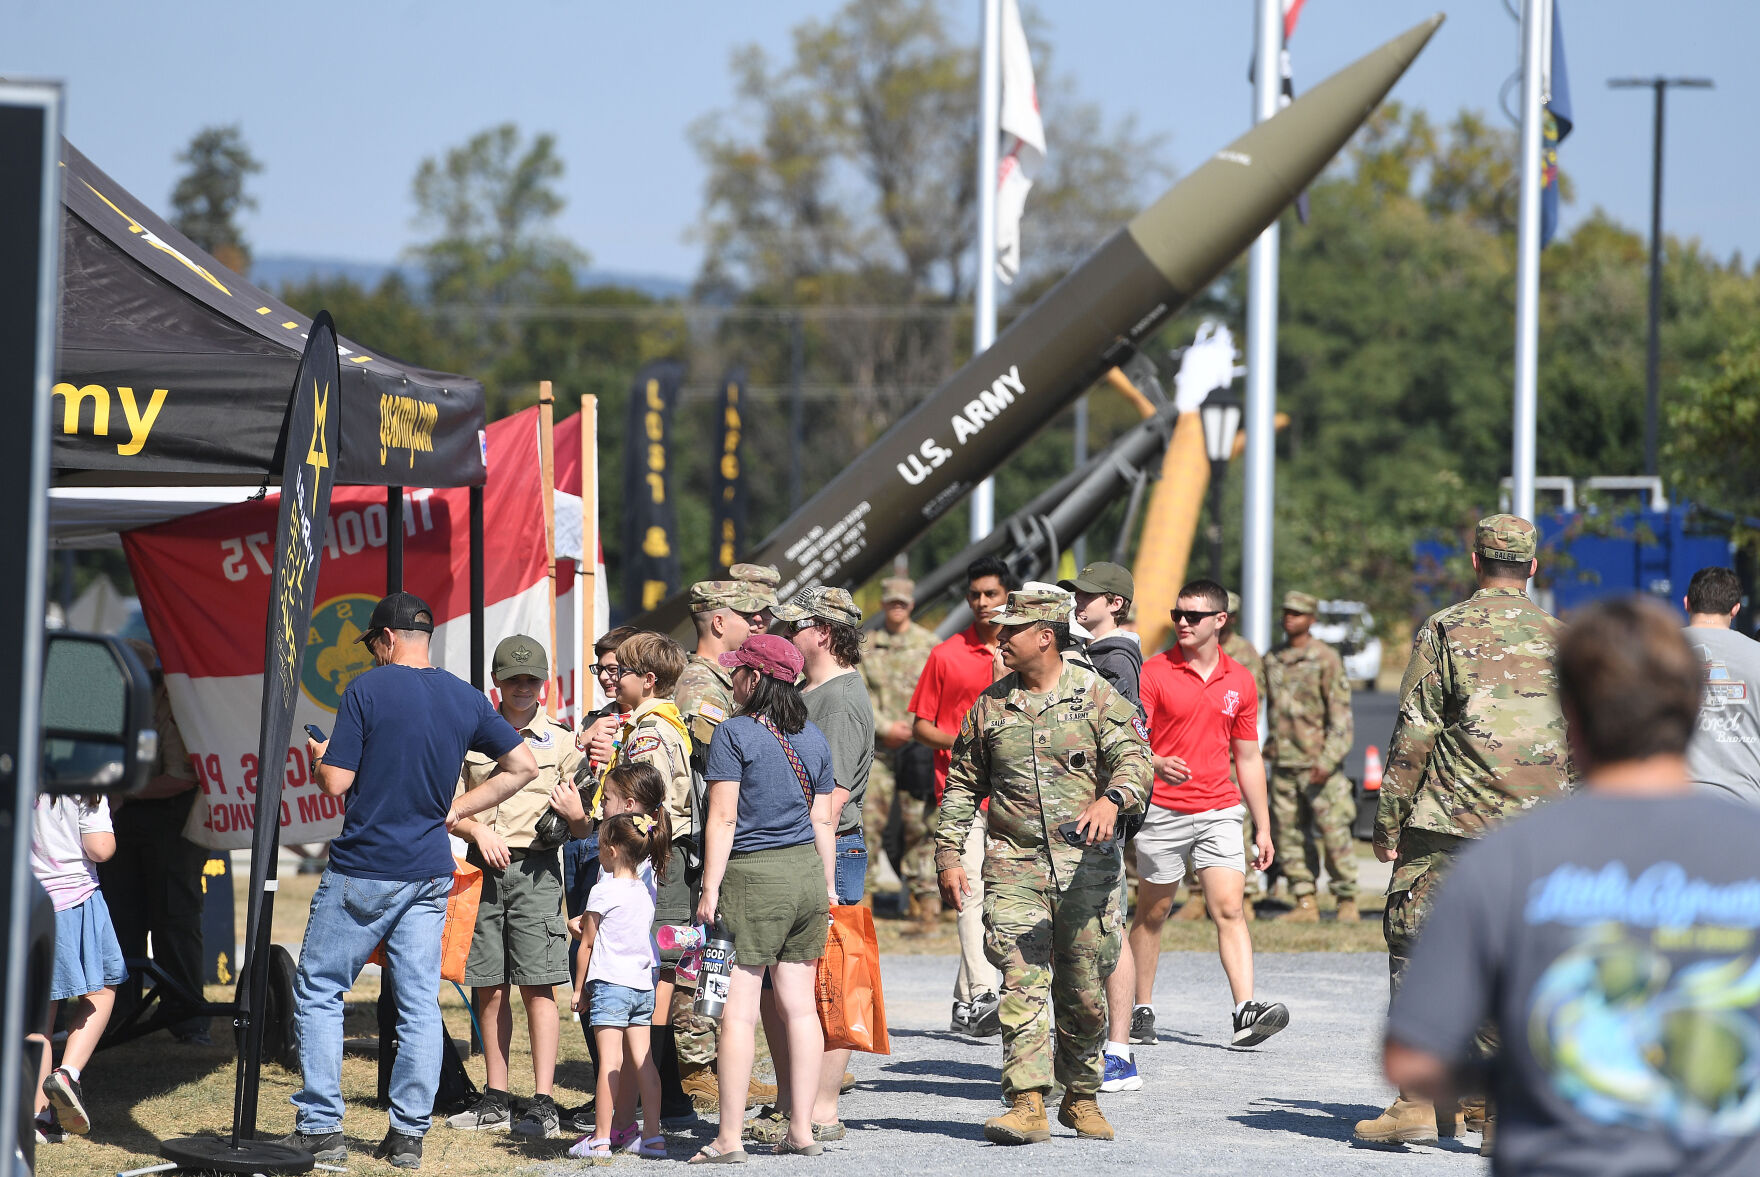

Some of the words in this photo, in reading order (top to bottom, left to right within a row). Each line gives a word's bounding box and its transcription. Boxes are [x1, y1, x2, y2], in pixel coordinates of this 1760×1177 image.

[896, 437, 953, 485] U.S.
[951, 364, 1026, 445] ARMY
[706, 948, 725, 960] GOD
[703, 961, 723, 974] TRUST
